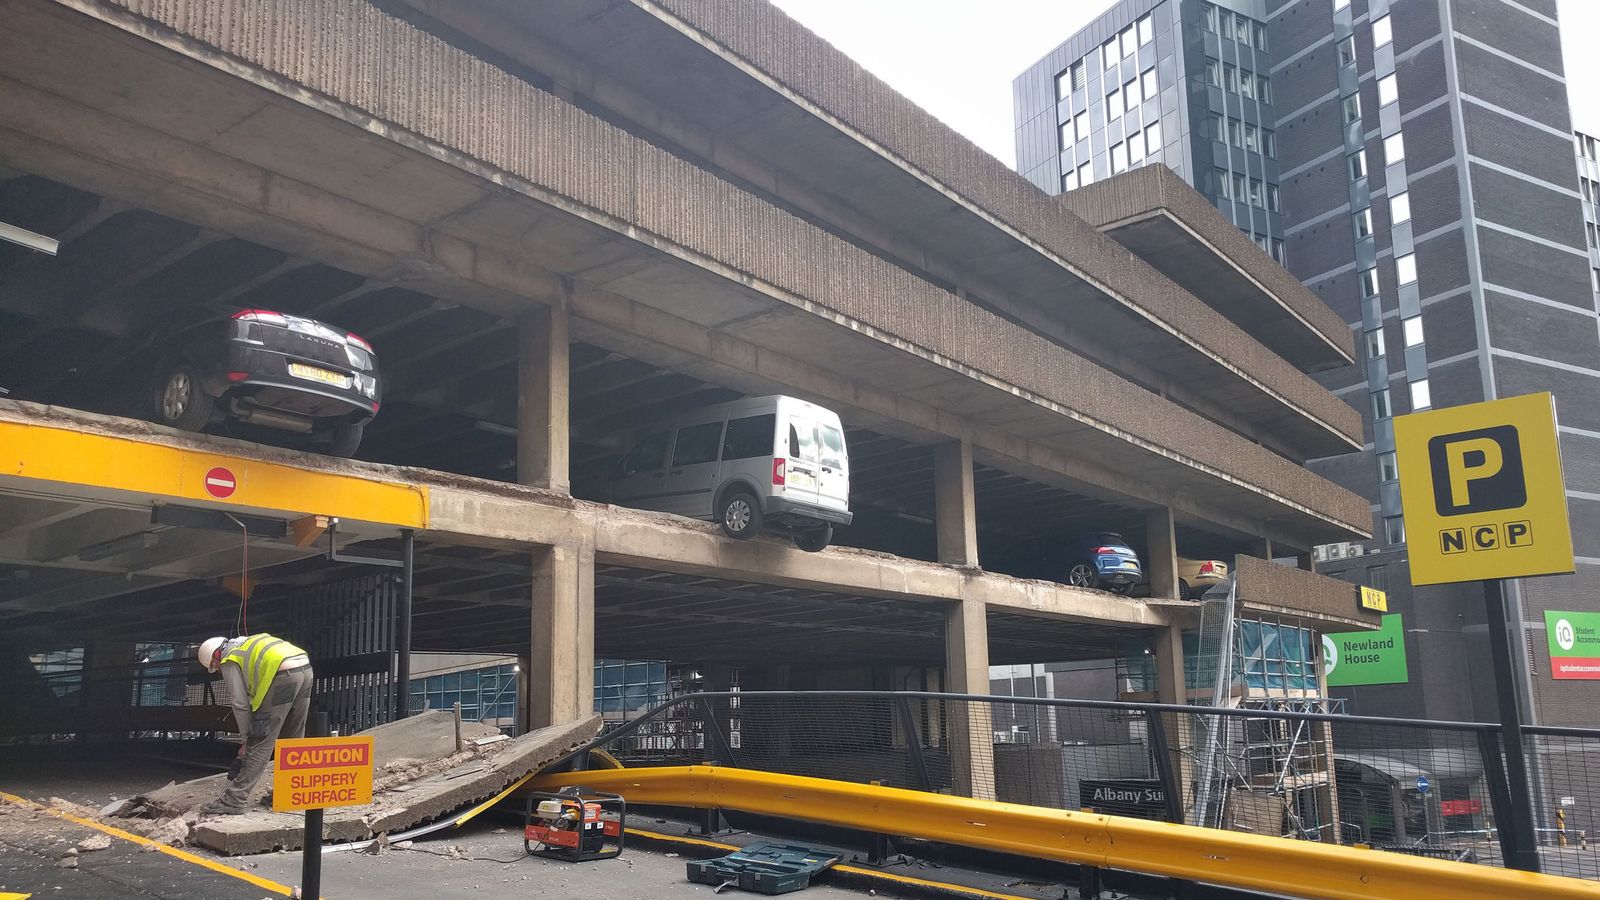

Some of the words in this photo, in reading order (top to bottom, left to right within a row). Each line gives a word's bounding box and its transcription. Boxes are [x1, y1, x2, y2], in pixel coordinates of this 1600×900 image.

[1445, 437, 1504, 507] P
[1441, 523, 1527, 552] NCP
[1366, 589, 1381, 607] NCP
[1576, 626, 1596, 635] Student
[1343, 637, 1394, 652] Newland
[1344, 654, 1380, 665] House
[286, 748, 363, 766] CAUTION
[291, 772, 358, 789] SLIPPERY
[291, 788, 357, 806] SURFACE
[1094, 787, 1142, 804] Albany
